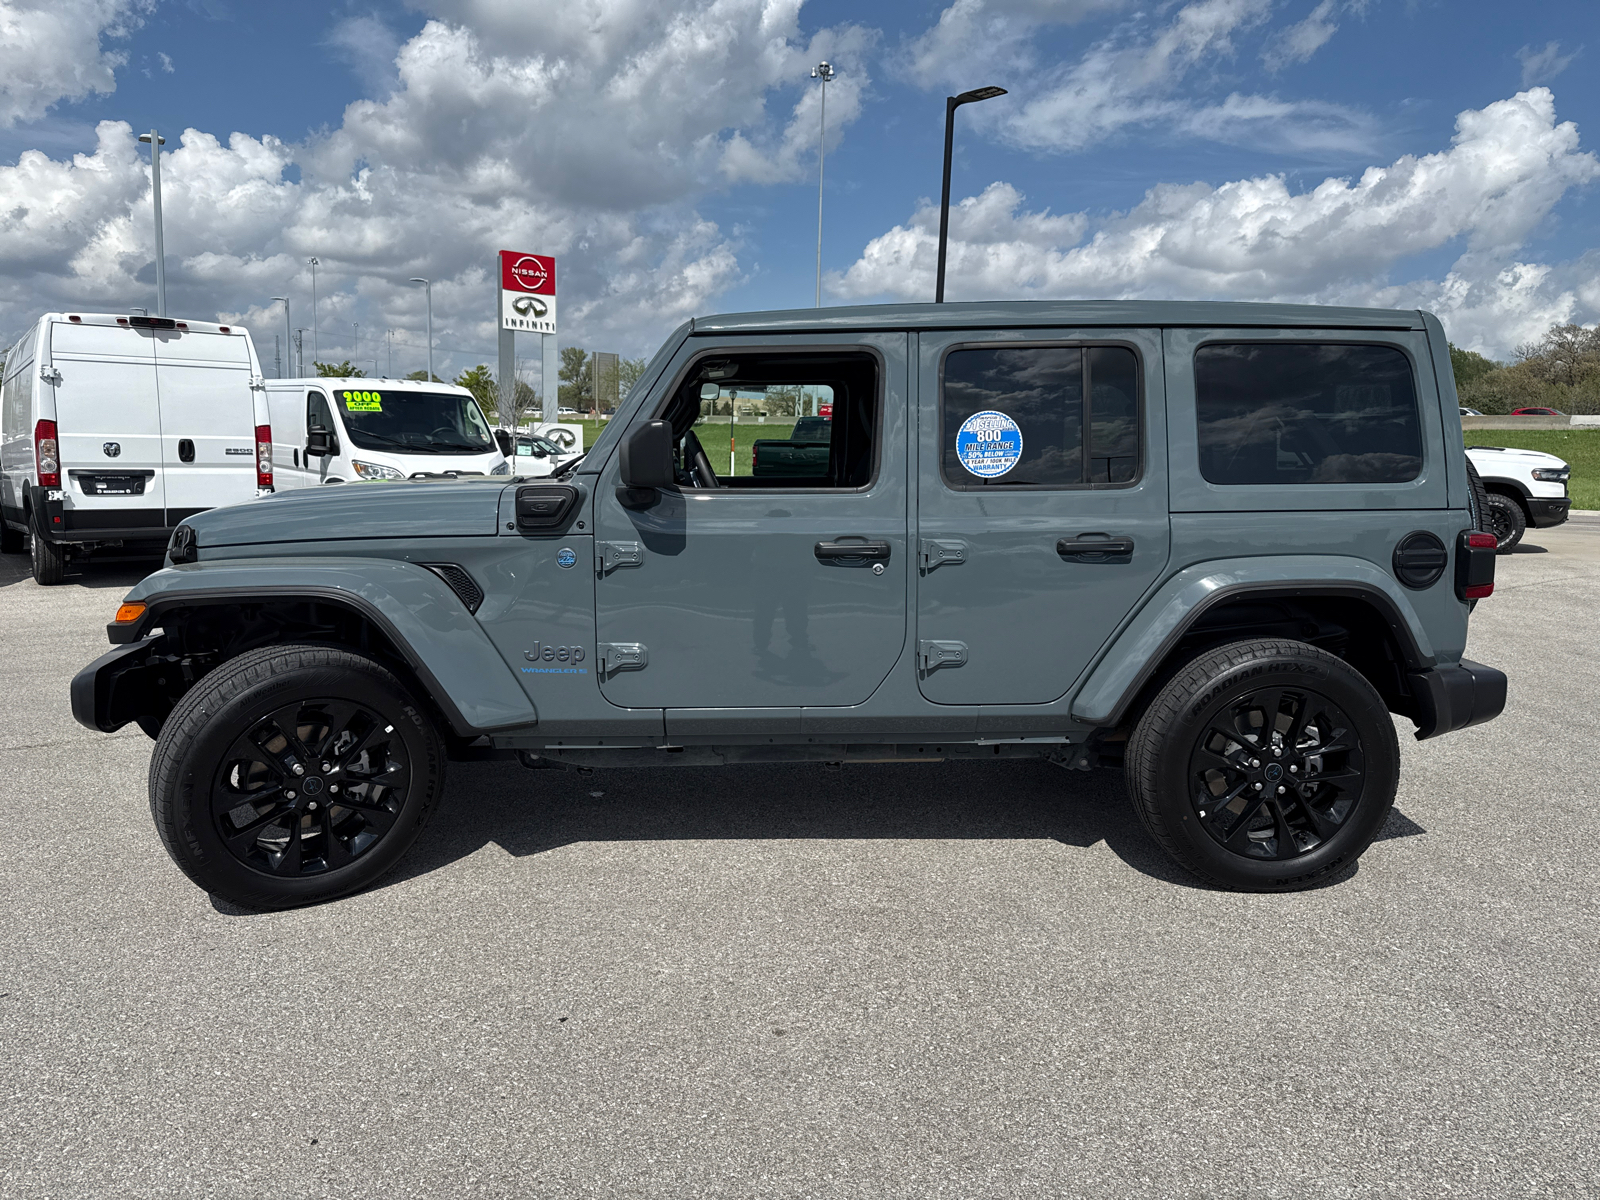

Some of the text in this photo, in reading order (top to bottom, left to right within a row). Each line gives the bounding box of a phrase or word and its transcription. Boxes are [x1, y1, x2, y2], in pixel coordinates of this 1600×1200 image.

[511, 267, 548, 278] NISSAN
[505, 317, 556, 331] INFINITI
[342, 391, 382, 403] 9000
[979, 419, 1013, 429] SELLING
[976, 429, 1002, 443] 800
[965, 441, 1014, 451] MILE RANGE
[967, 451, 983, 459] 50%
[984, 450, 1005, 458] BELOW
[523, 640, 586, 666] Jeep
[1191, 665, 1263, 717] ROADIAN
[403, 705, 437, 774] ROADIAN
[181, 783, 204, 857] NEXEN
[1276, 856, 1343, 886] NEXEN
